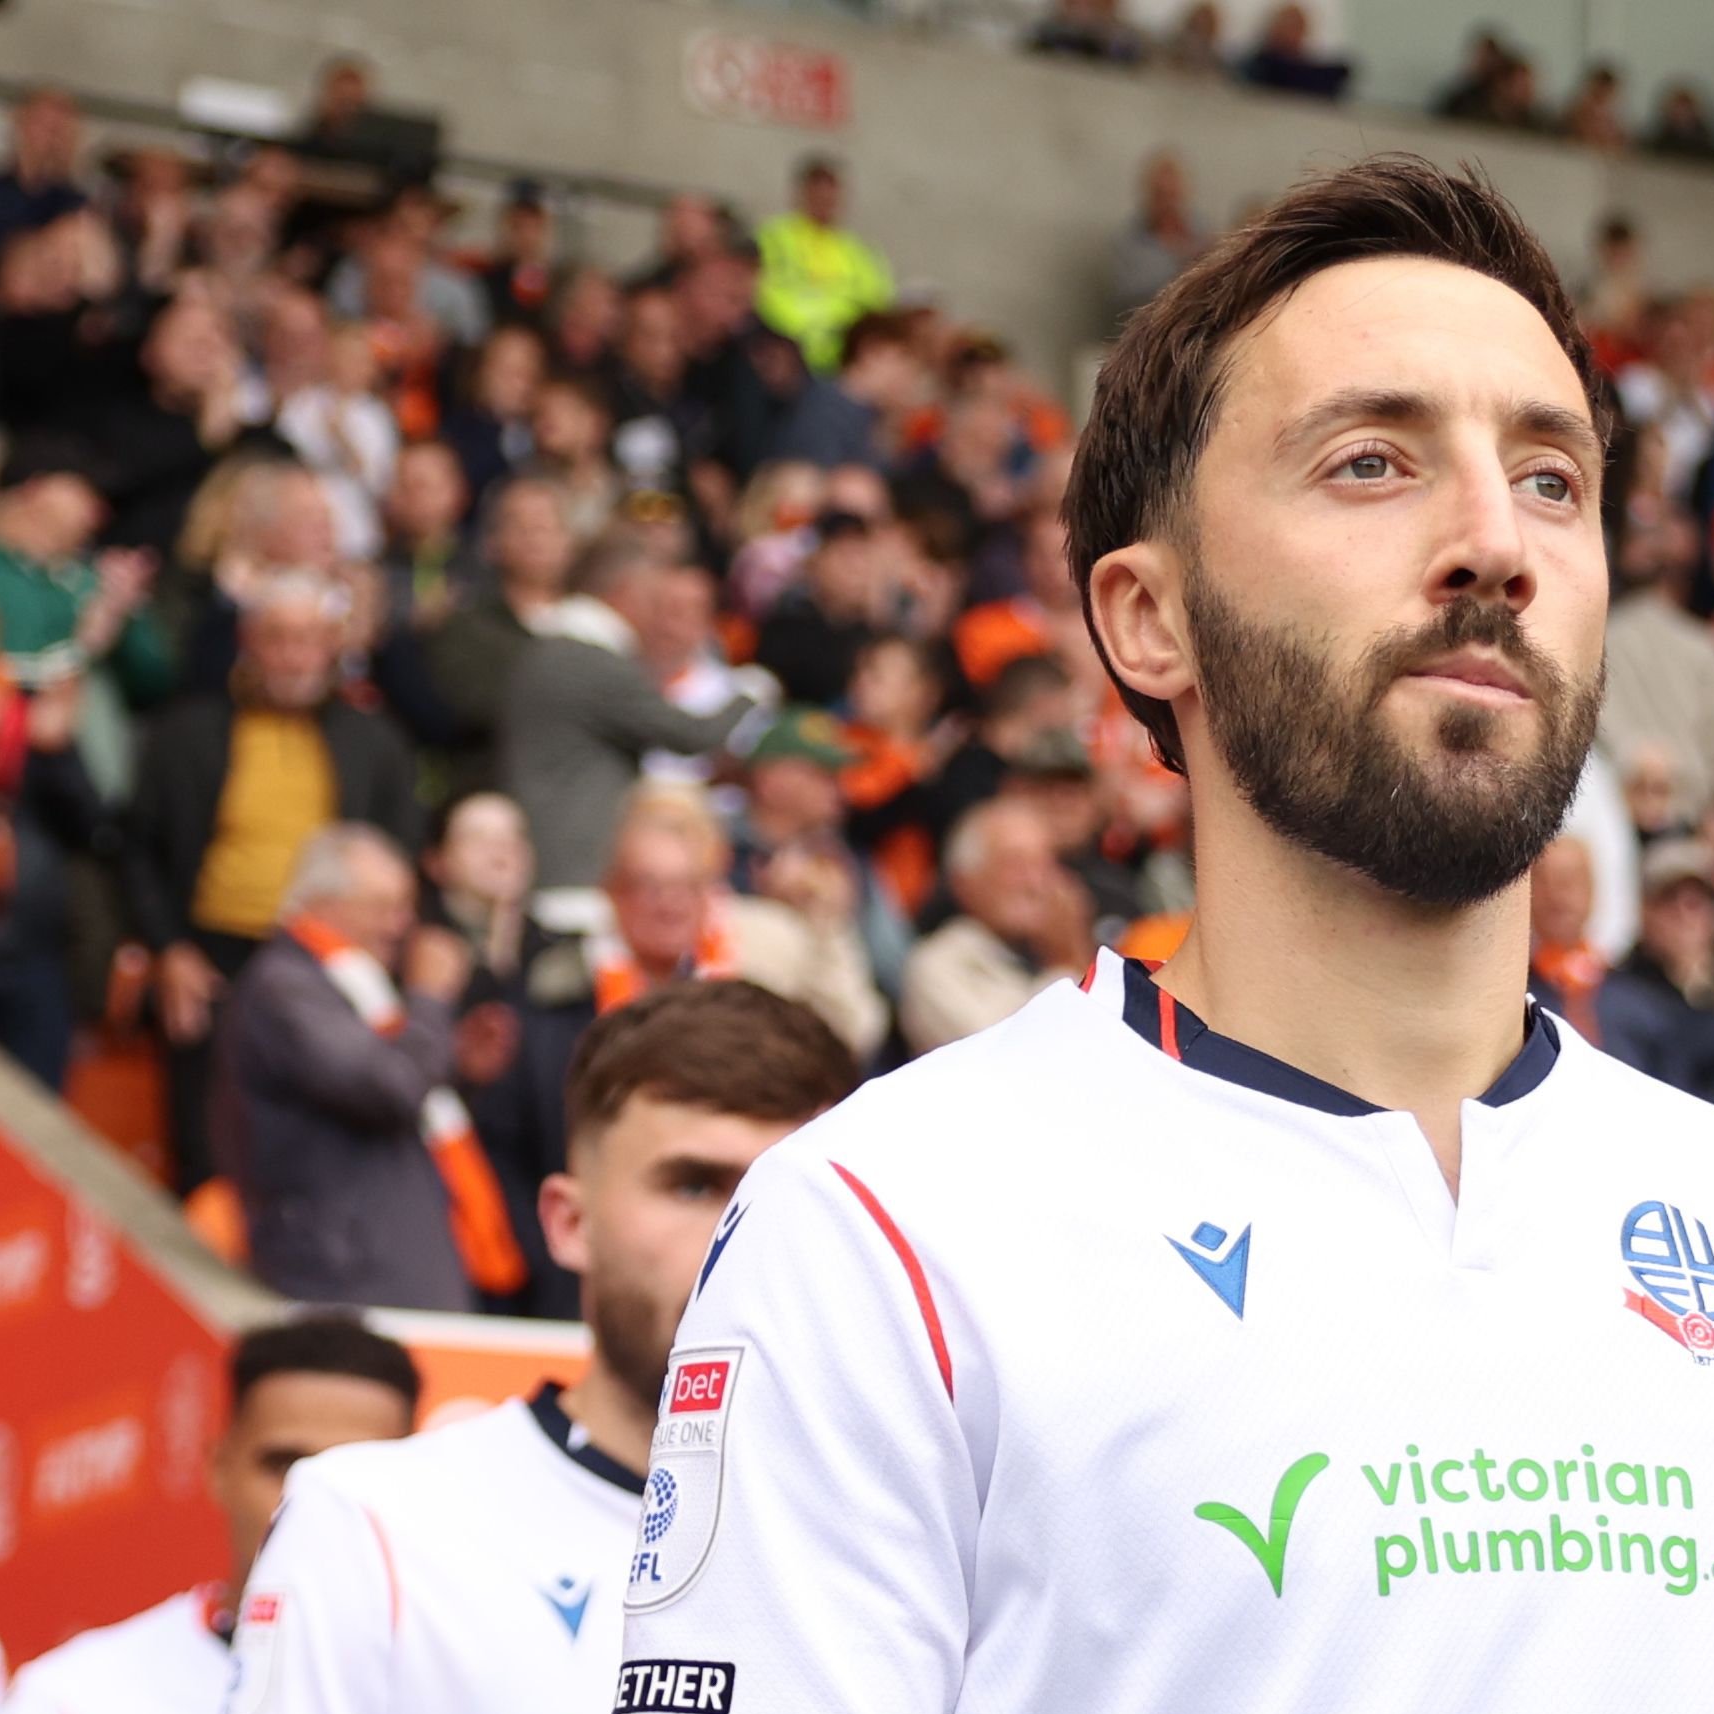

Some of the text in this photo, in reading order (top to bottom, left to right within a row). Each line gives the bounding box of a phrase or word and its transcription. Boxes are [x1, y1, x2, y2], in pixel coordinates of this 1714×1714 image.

[675, 1368, 721, 1402] bet
[681, 1420, 715, 1444] ONE
[1360, 1443, 1694, 1509] victorian
[613, 1665, 727, 1711] ETHER
